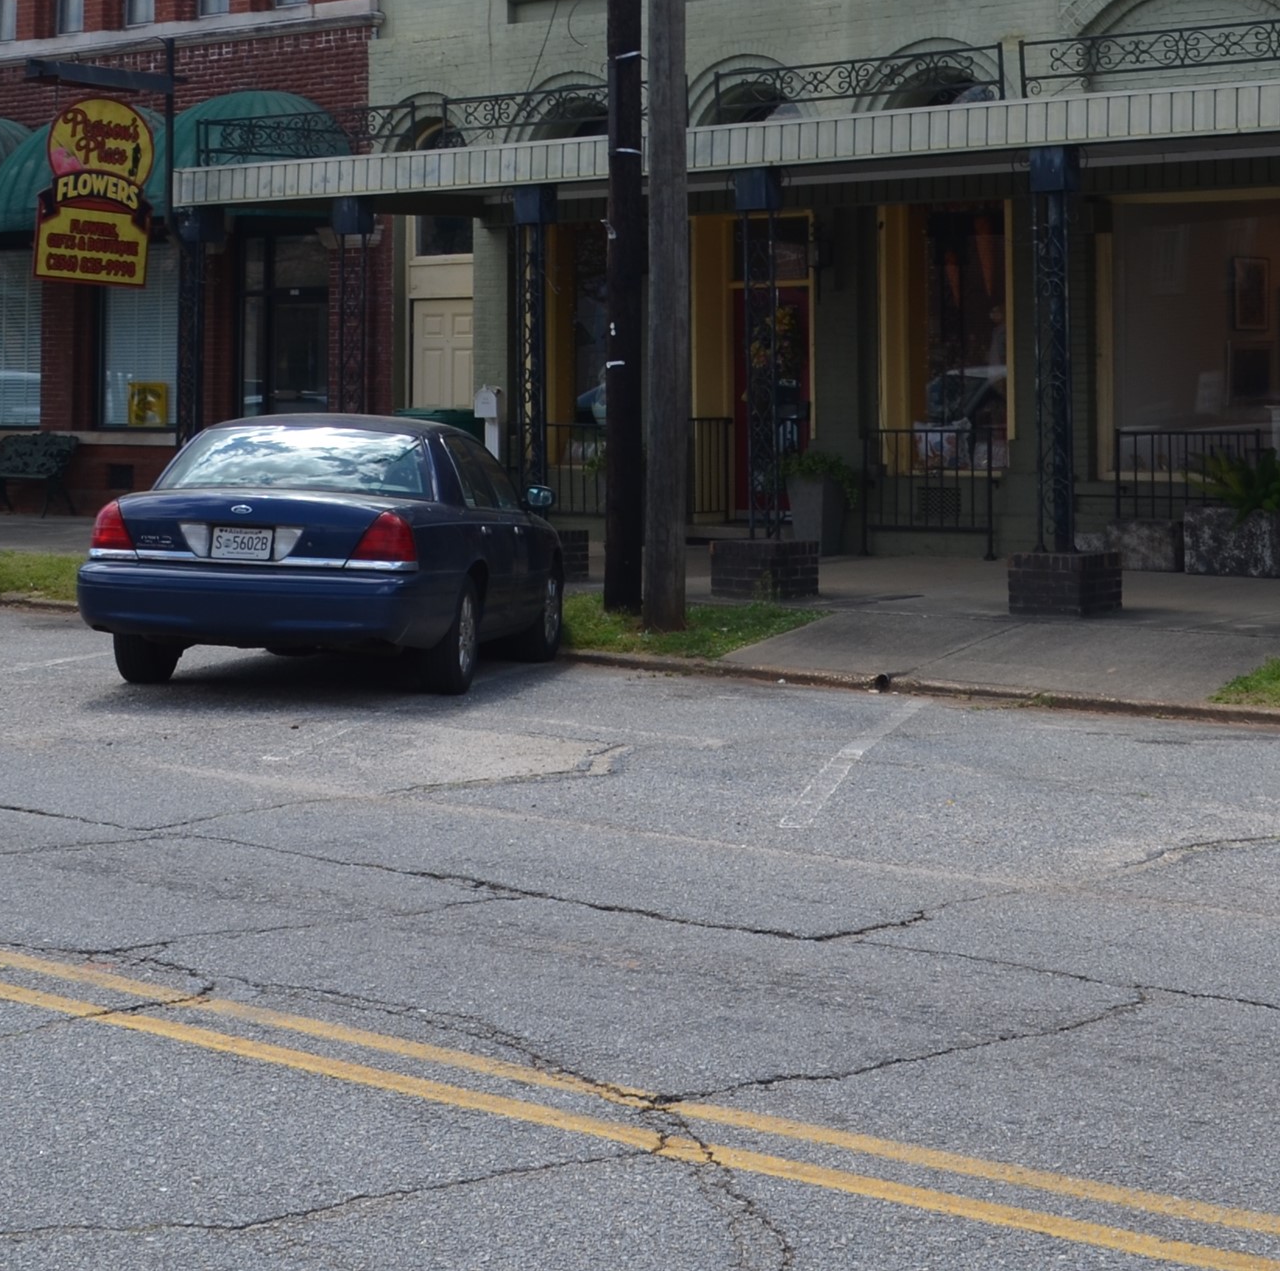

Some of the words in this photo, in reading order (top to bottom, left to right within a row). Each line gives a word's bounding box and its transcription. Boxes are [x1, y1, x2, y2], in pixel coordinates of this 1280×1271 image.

[75, 134, 128, 166] Place
[56, 173, 139, 210] FLOWERS
[86, 236, 139, 257] BOUTIQUE
[215, 535, 223, 550] S
[232, 536, 269, 551] 5602B
